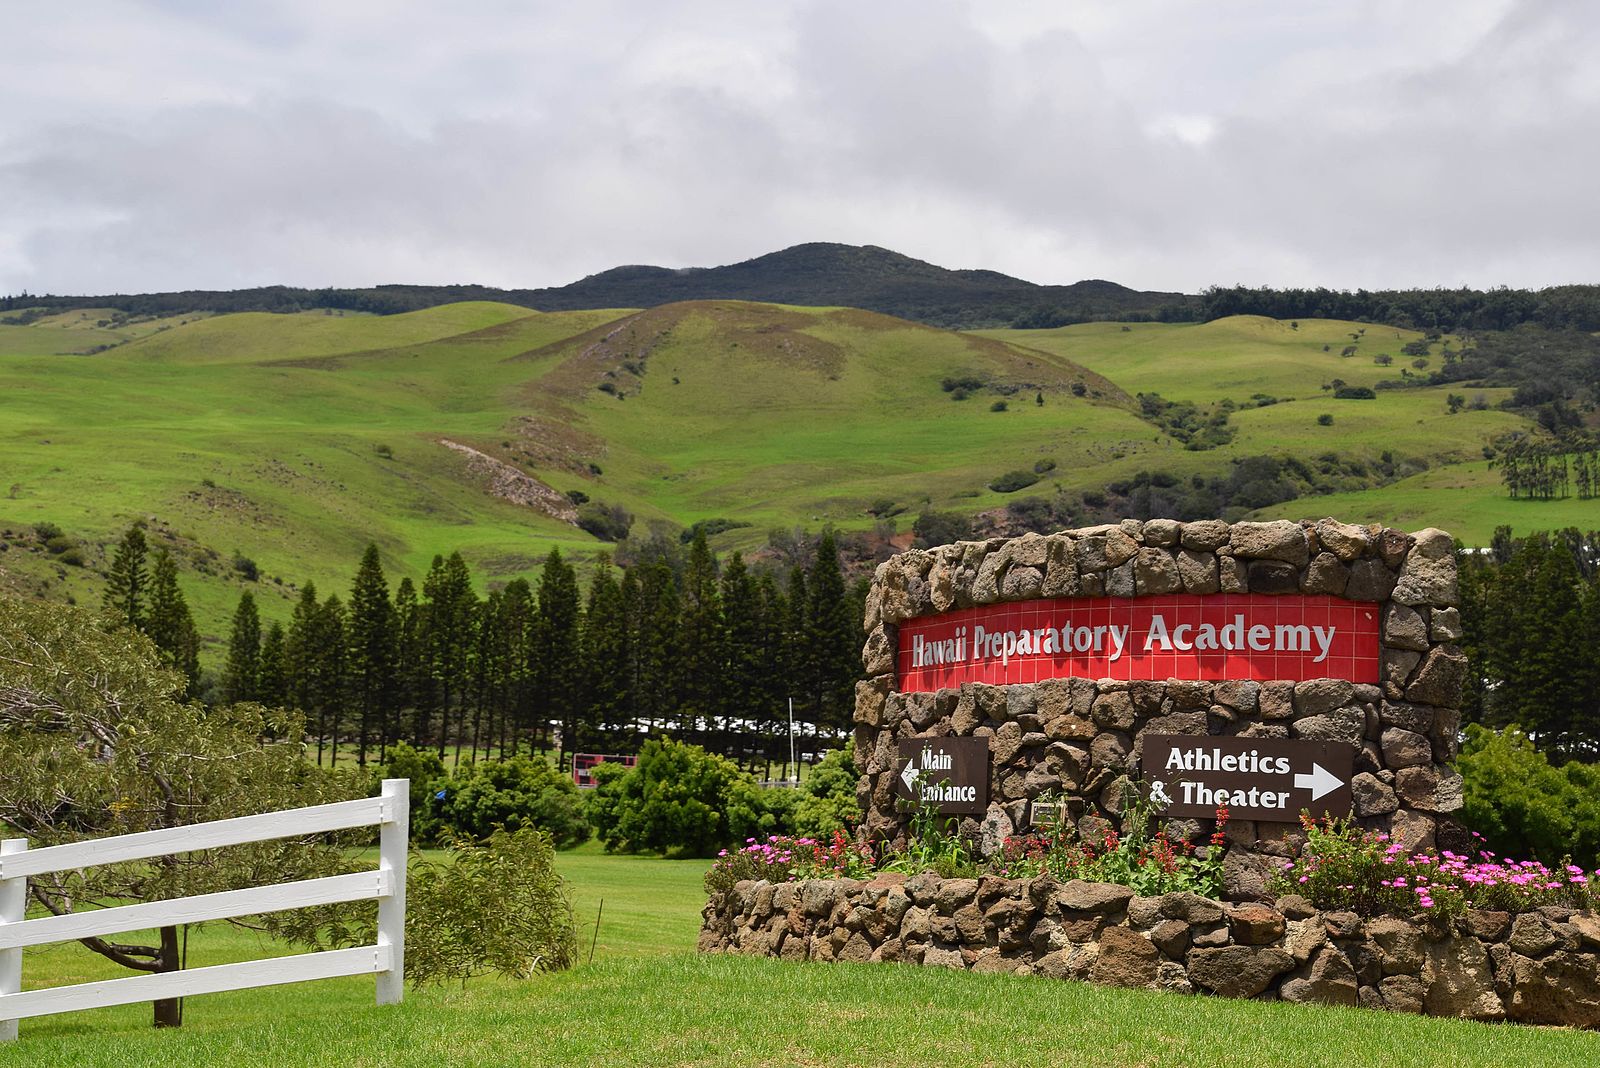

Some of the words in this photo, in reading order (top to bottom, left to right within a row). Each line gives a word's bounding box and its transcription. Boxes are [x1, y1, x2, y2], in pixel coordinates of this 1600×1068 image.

[912, 625, 967, 667] Hawaii
[974, 620, 1129, 666] Preparatory
[1143, 614, 1336, 663] Academy
[920, 749, 952, 770] Main
[1165, 747, 1291, 774] Athletics
[1150, 780, 1174, 804] &
[1180, 781, 1290, 809] Theater
